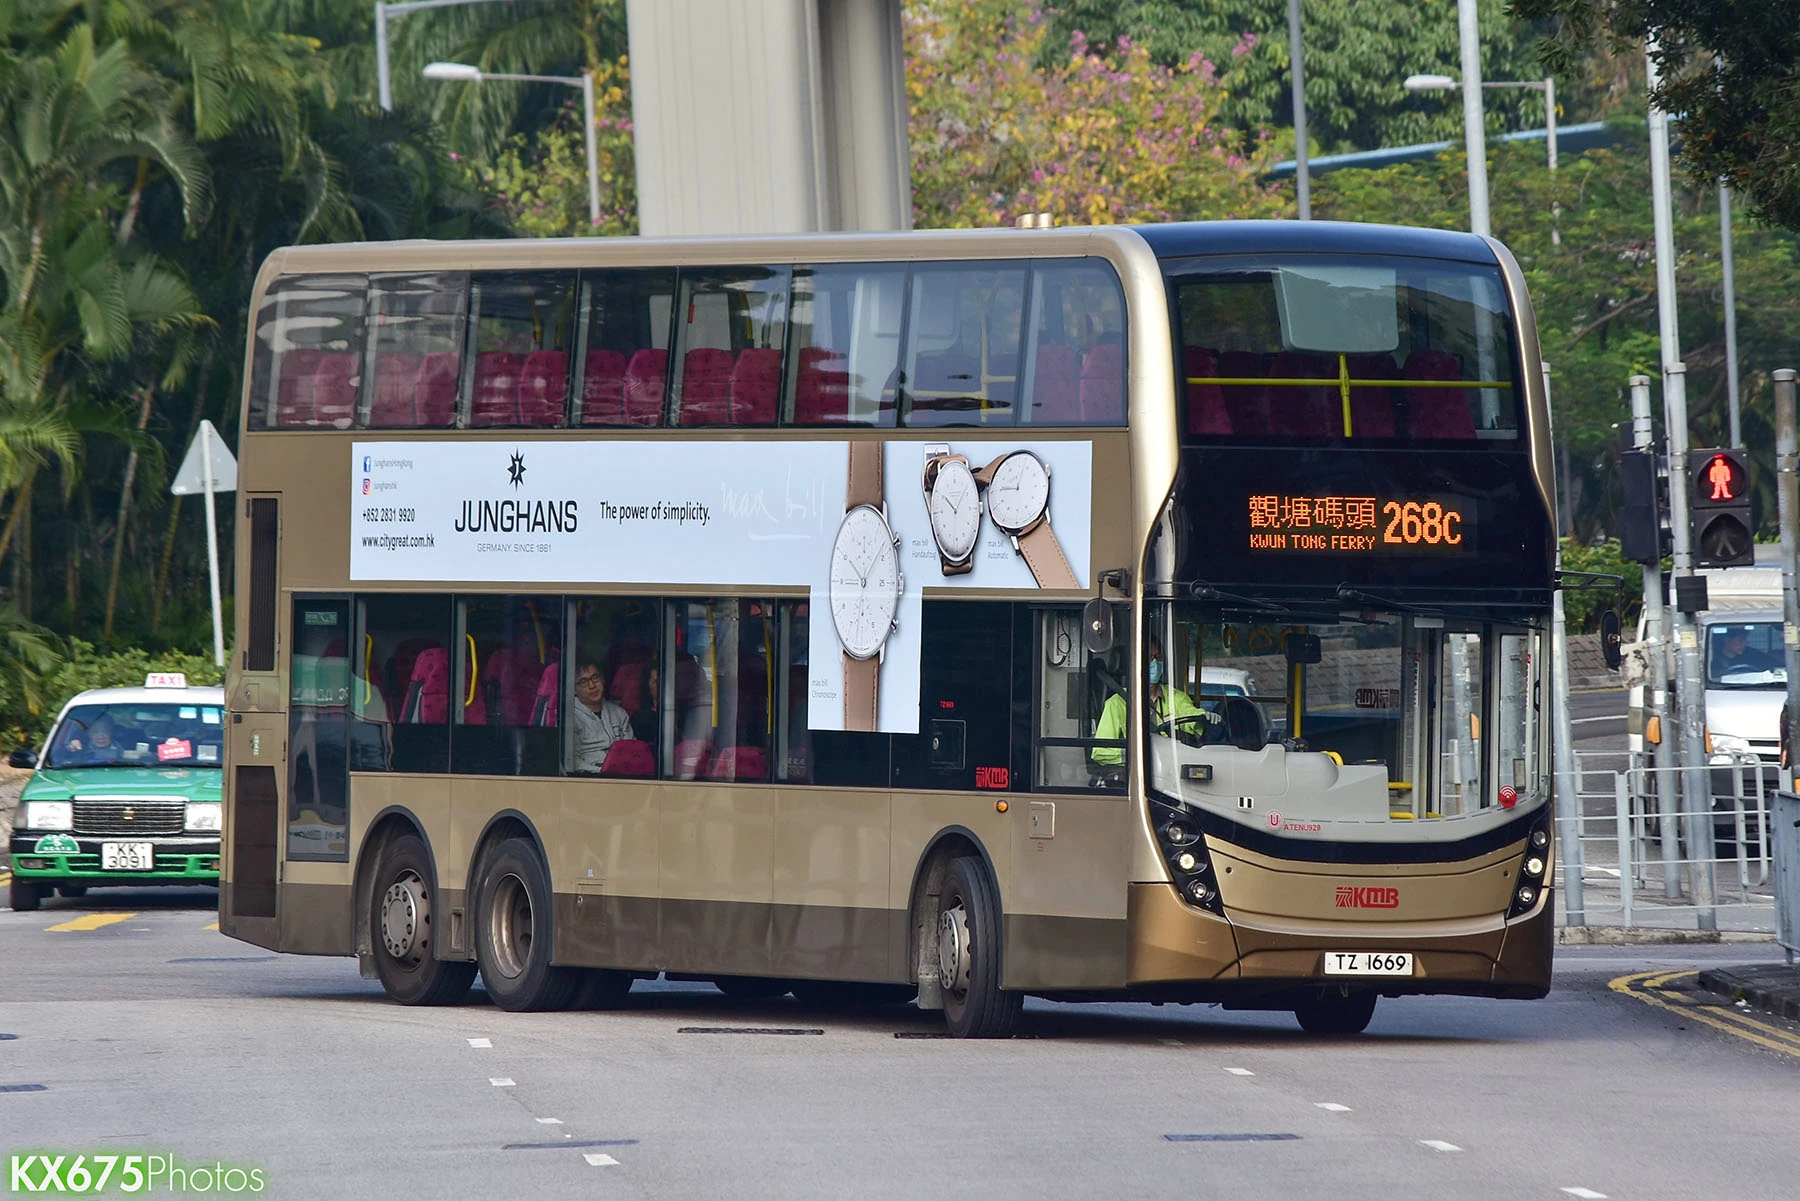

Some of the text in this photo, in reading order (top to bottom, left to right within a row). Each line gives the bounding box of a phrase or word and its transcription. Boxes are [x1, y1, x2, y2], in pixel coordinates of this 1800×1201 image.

[362, 508, 416, 522] +852 2831 9920
[454, 500, 578, 533] JUNGHANS
[600, 500, 710, 526] The power of simplicity.
[1249, 495, 1377, 530] 觀塘碼頭
[361, 533, 435, 551] www.citygreat.com.hk
[514, 544, 534, 553] SINCE
[536, 544, 552, 553] 1861
[1250, 534, 1376, 550] KWUN TONG FERRY
[151, 675, 182, 686] TAXI
[985, 767, 1009, 788] KMB
[117, 843, 138, 855] KK
[108, 855, 147, 867] 3091
[1353, 887, 1400, 909] KMB
[1335, 954, 1406, 971] TZ 1669
